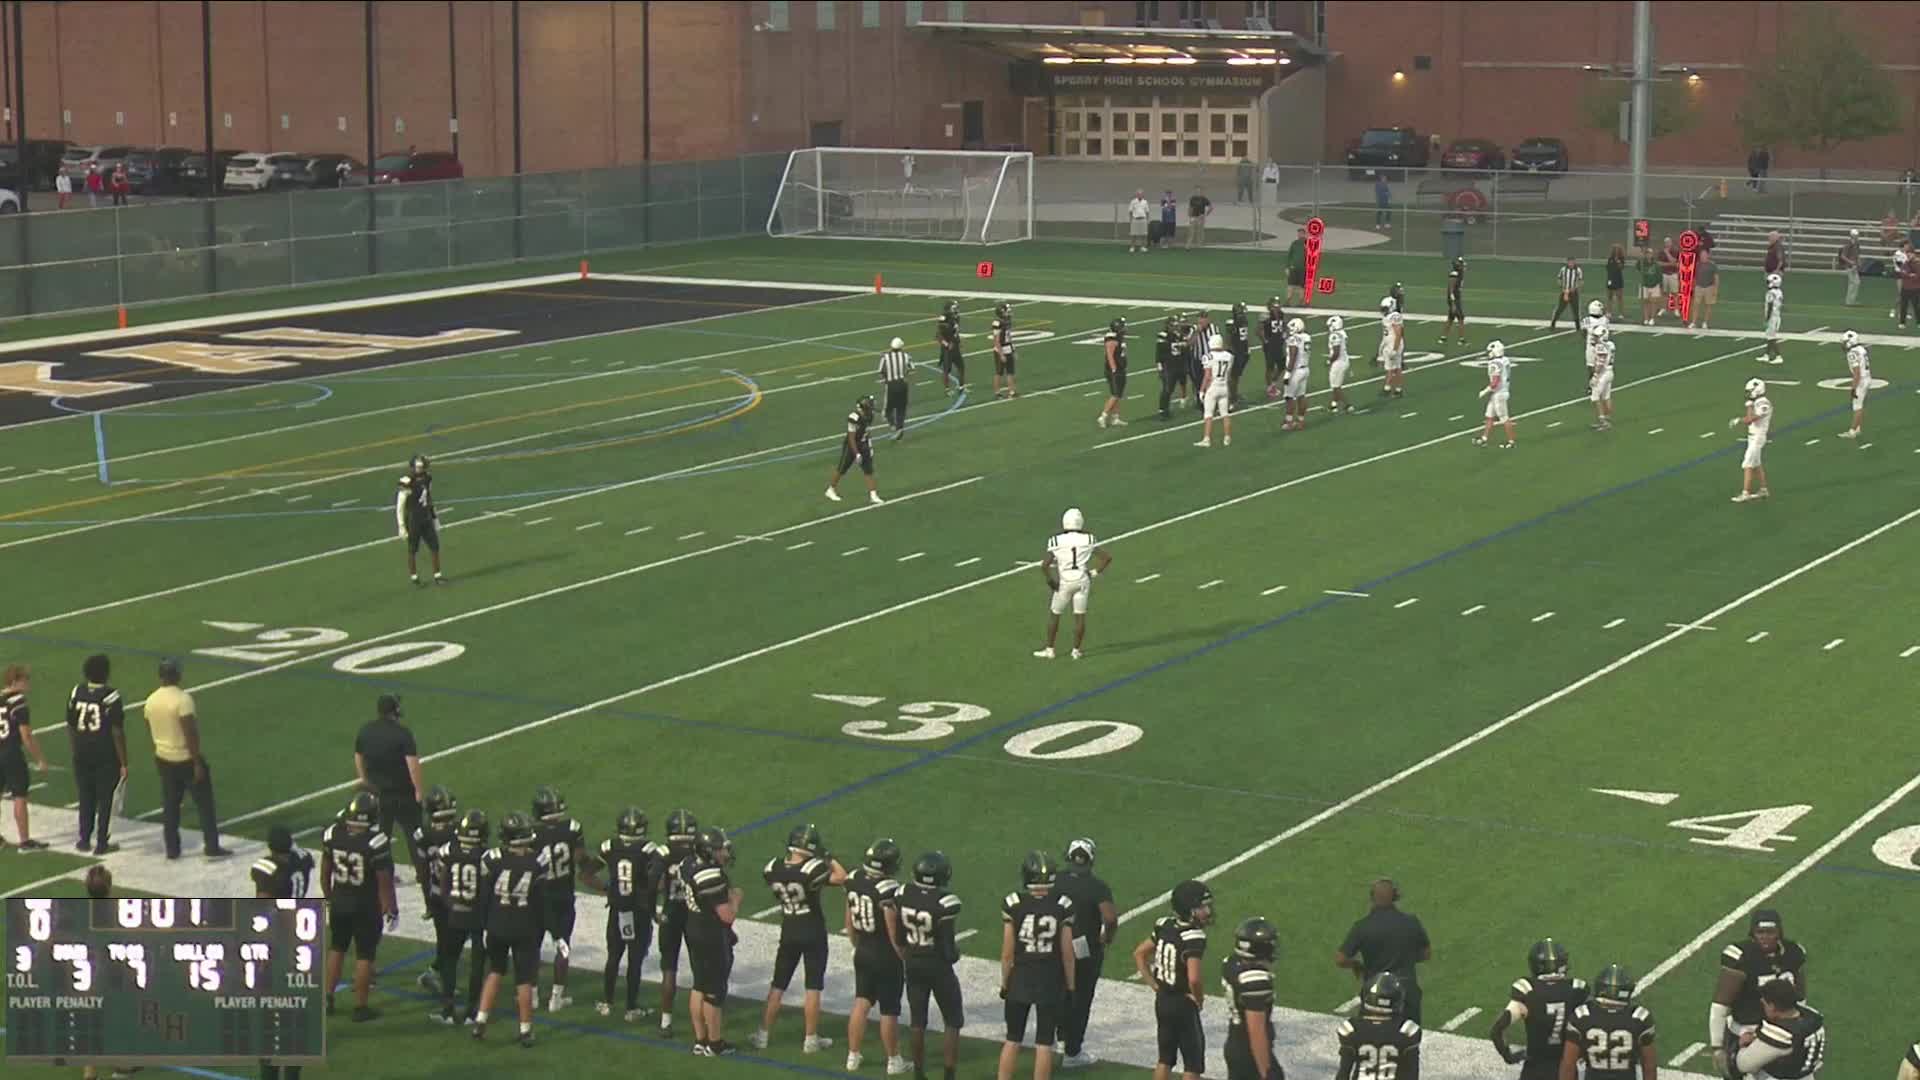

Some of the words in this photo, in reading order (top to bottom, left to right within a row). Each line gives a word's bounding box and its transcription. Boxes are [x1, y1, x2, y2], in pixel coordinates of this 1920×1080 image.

[1104, 75, 1133, 86] HIGH
[1137, 75, 1185, 86] SCHOOL
[1189, 75, 1262, 86] GYMNASIUM
[1216, 360, 1230, 379] 17
[1071, 546, 1079, 570] 1
[76, 701, 102, 731] 73
[841, 701, 1144, 760] 30
[333, 851, 365, 885] 53
[450, 863, 477, 900] 19
[494, 869, 532, 907] 44
[772, 882, 810, 915] 32
[848, 891, 876, 933] 20
[901, 906, 934, 946] 52
[1018, 914, 1057, 953] 42
[1151, 938, 1177, 986] 40
[1357, 1044, 1399, 1080] 26
[1586, 1028, 1633, 1070] 22
